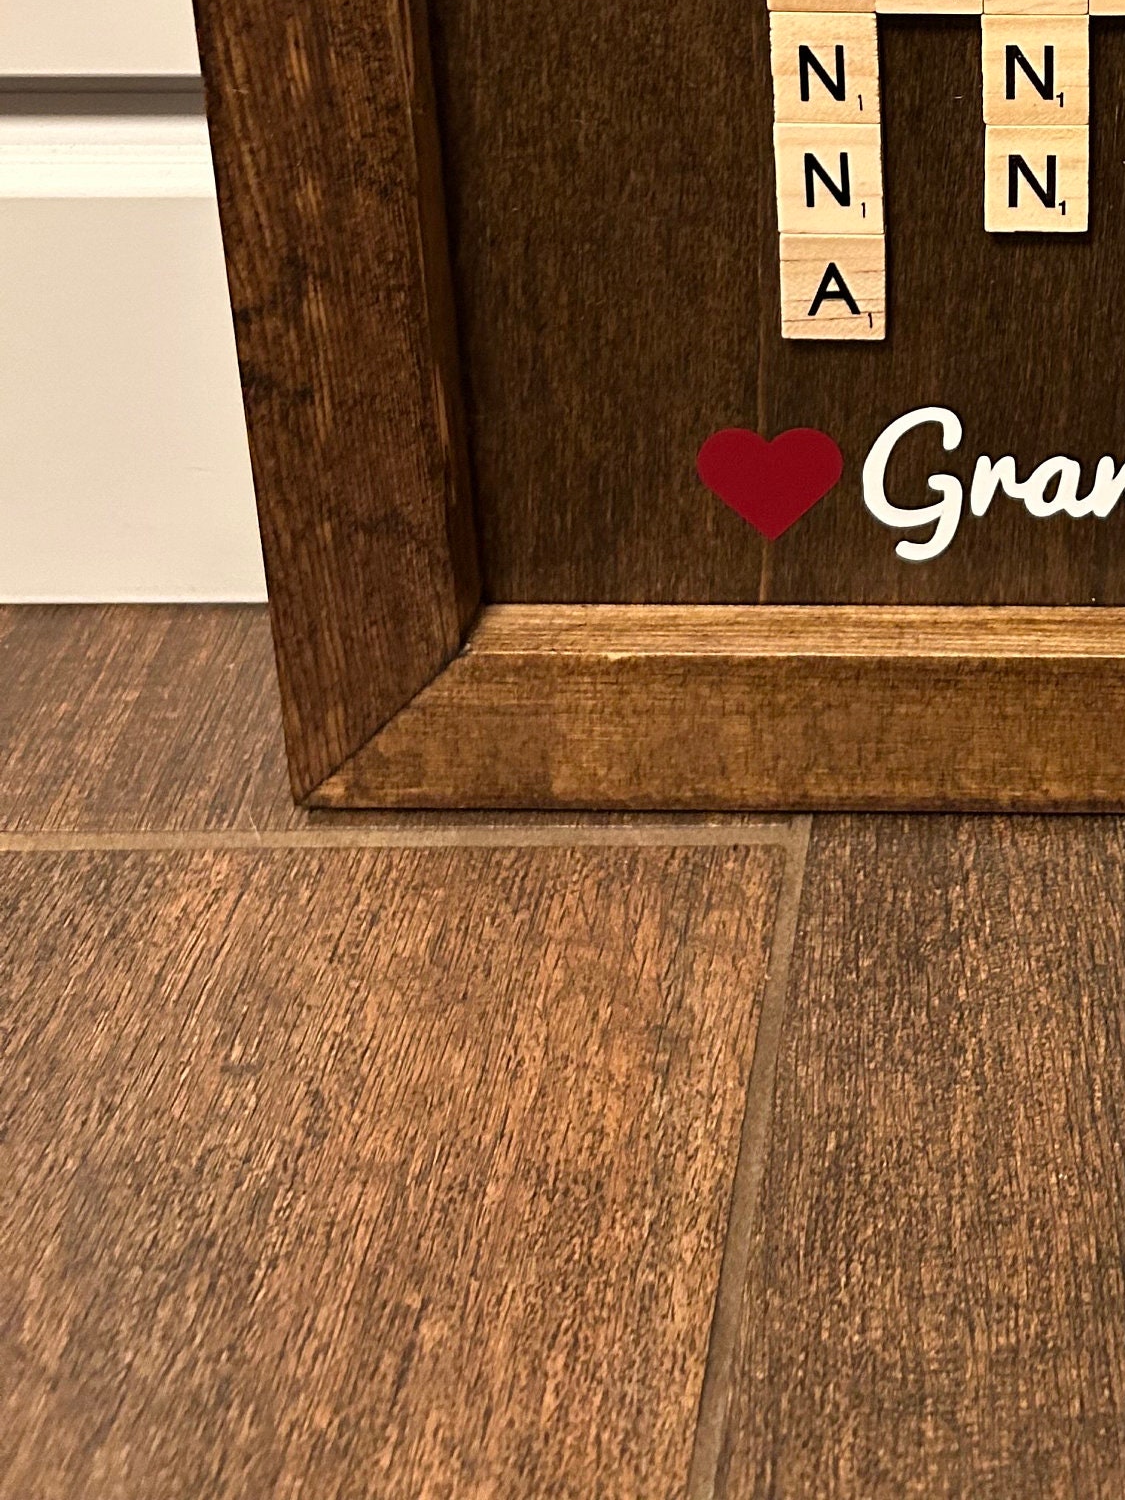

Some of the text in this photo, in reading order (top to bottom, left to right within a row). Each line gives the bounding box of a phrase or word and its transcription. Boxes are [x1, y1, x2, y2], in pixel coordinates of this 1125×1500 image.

[857, 94, 863, 112] 1
[1055, 91, 1064, 108] 1
[861, 202, 867, 219] 1
[1058, 200, 1066, 216] 1
[866, 311, 873, 329] 1
